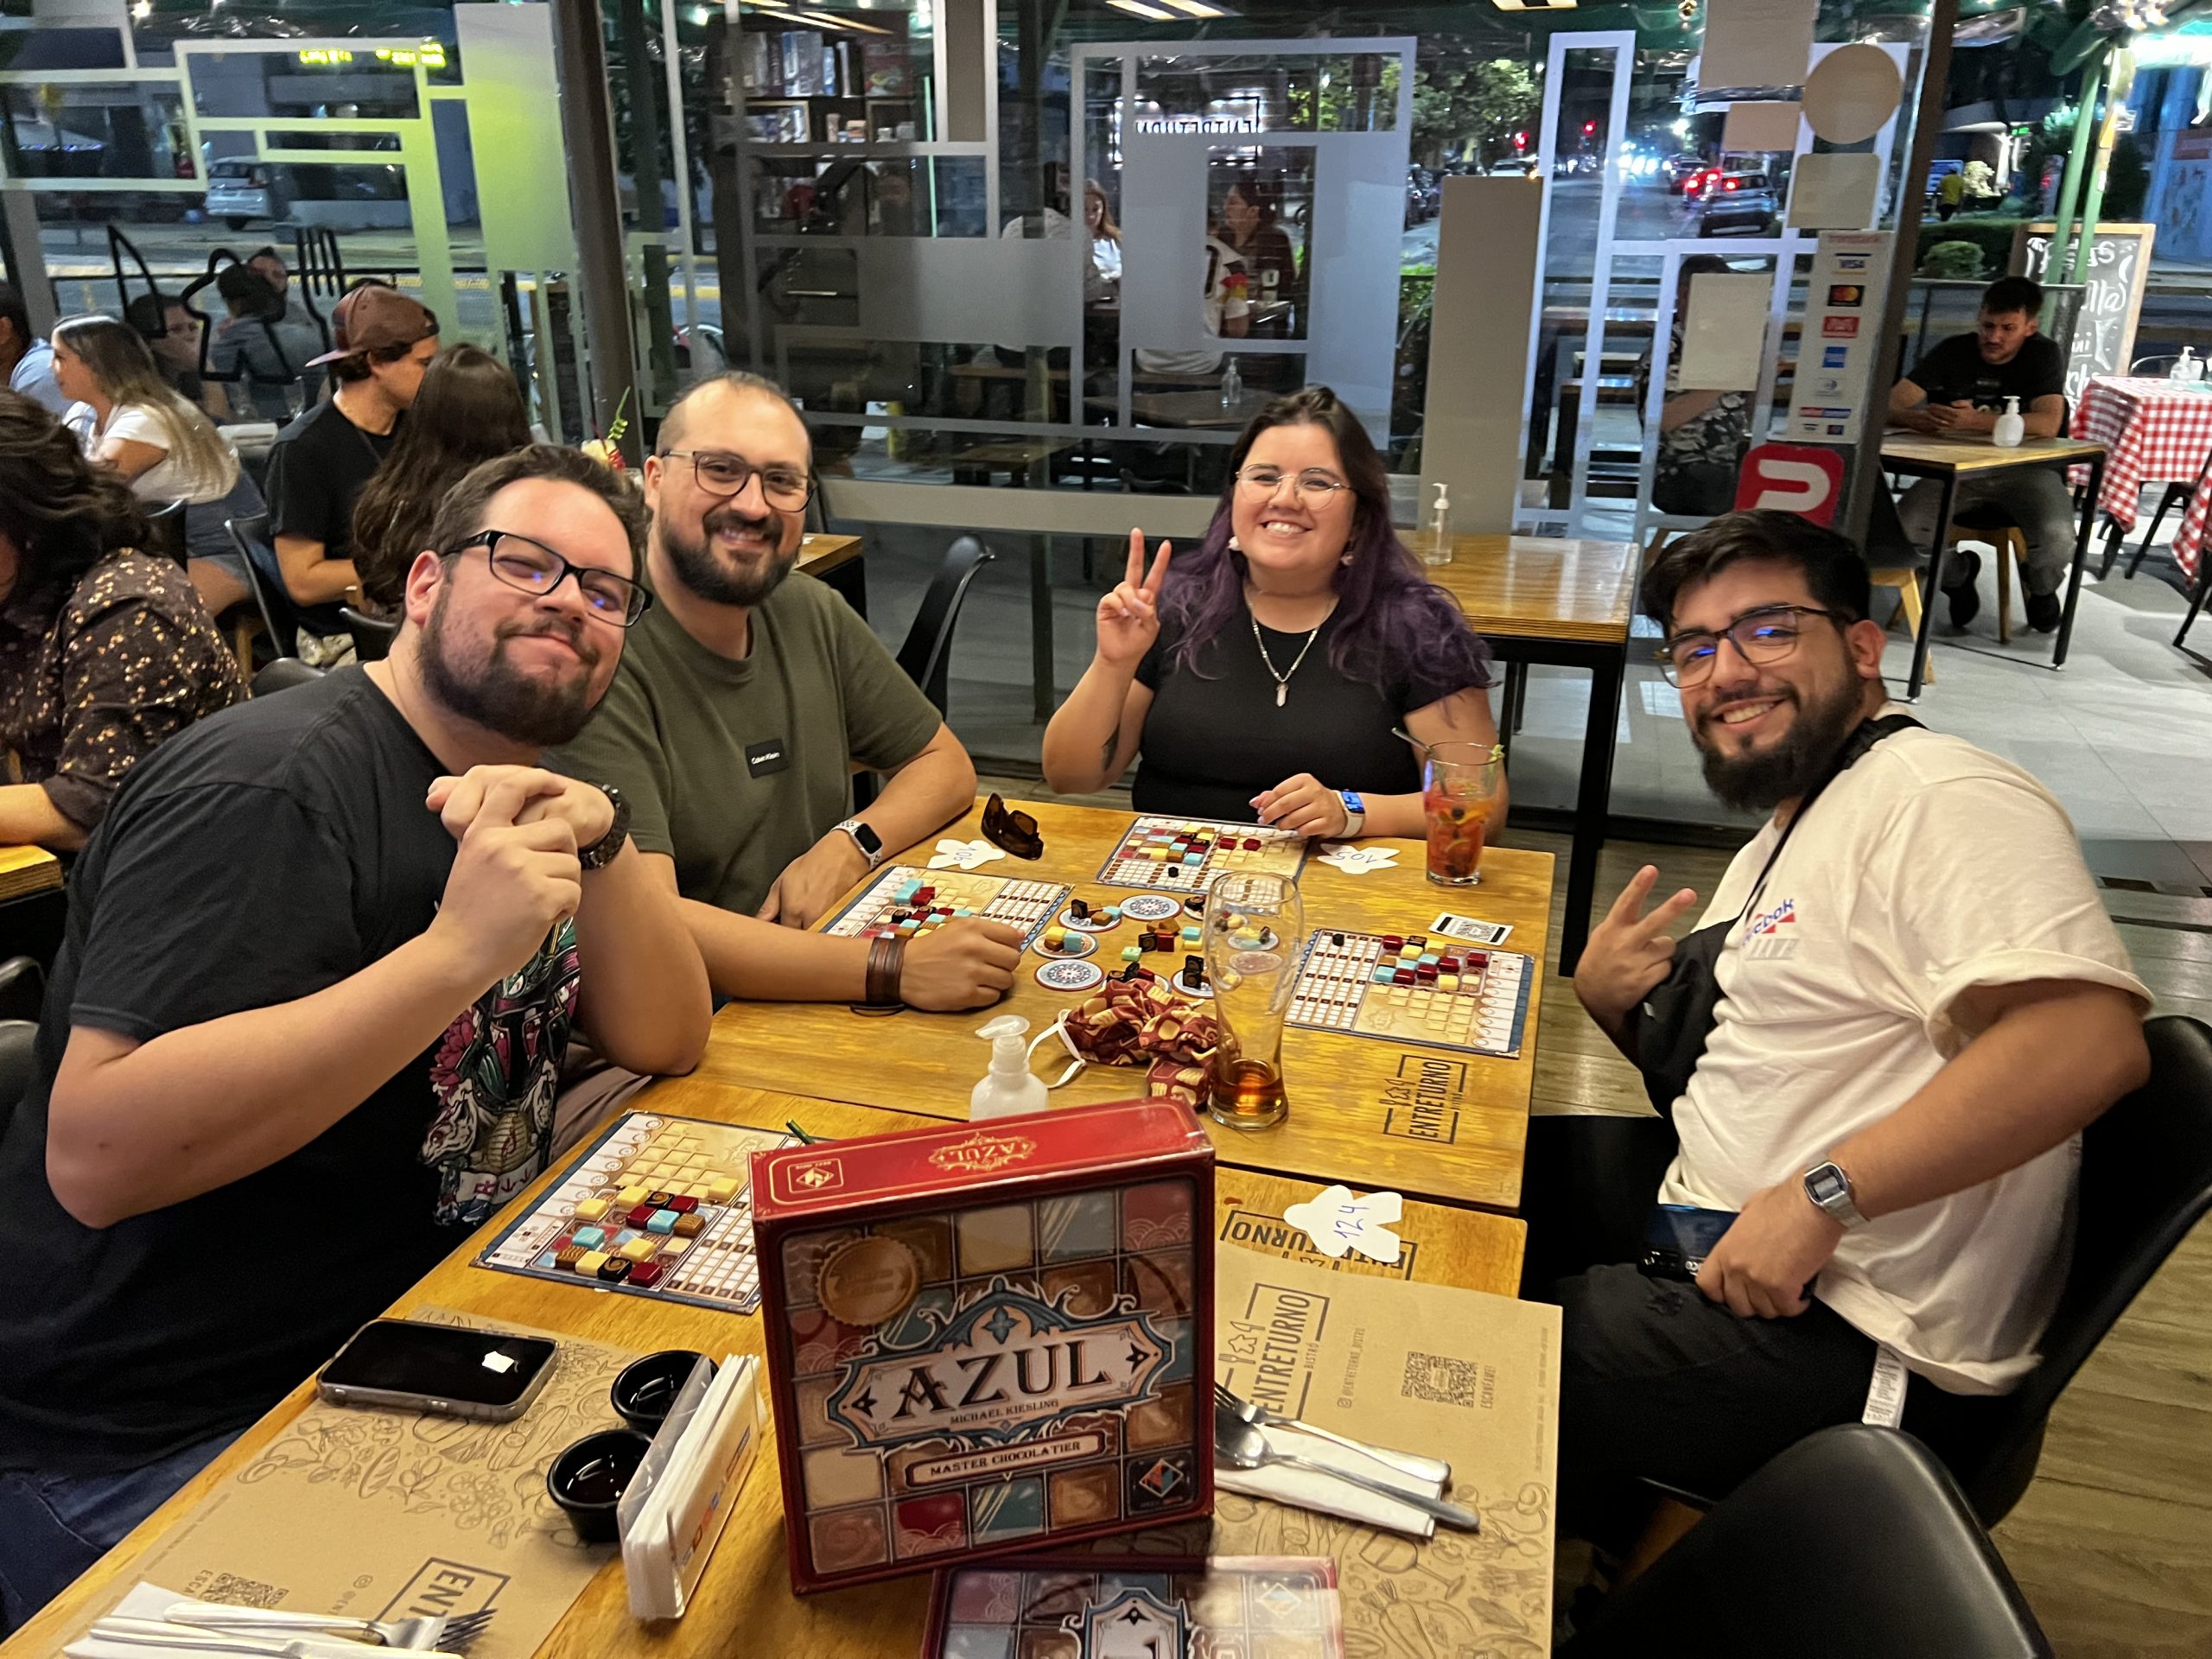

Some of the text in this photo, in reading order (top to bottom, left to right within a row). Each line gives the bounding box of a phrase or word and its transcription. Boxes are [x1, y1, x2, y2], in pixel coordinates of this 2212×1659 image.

[1333, 851, 1377, 864] 105
[1408, 1061, 1452, 1139] ENTRETURNO
[949, 1143, 1017, 1163] AZUL
[1333, 1204, 1370, 1239] 124
[1249, 1294, 1311, 1414] ENTRETURNO
[892, 1339, 1112, 1420] AZUL
[950, 1398, 1059, 1424] MICHAEL KIESLING
[930, 1440, 1081, 1477] MASTER CHOCOLATIER
